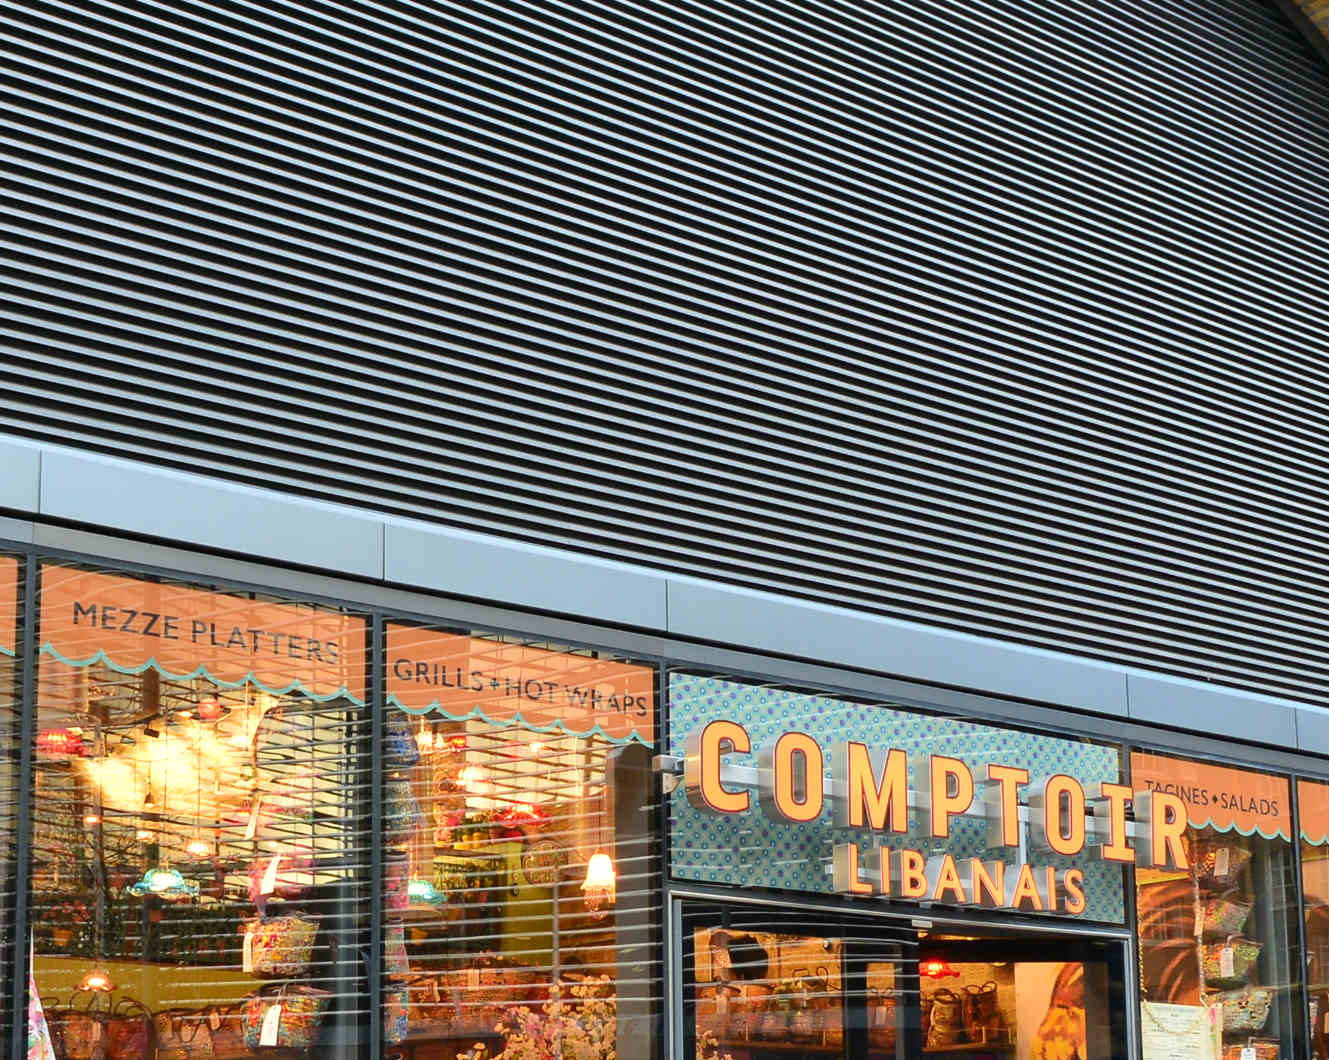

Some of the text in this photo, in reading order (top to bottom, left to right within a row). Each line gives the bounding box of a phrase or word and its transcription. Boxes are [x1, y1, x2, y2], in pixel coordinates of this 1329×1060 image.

[72, 600, 339, 665] MEZZE PLATTERS
[393, 658, 648, 717] GRILLS HOT WRAPS
[692, 719, 1190, 870] COMPTOIR
[1220, 792, 1280, 817] SALADS
[844, 842, 1087, 915] LIBANAIS
